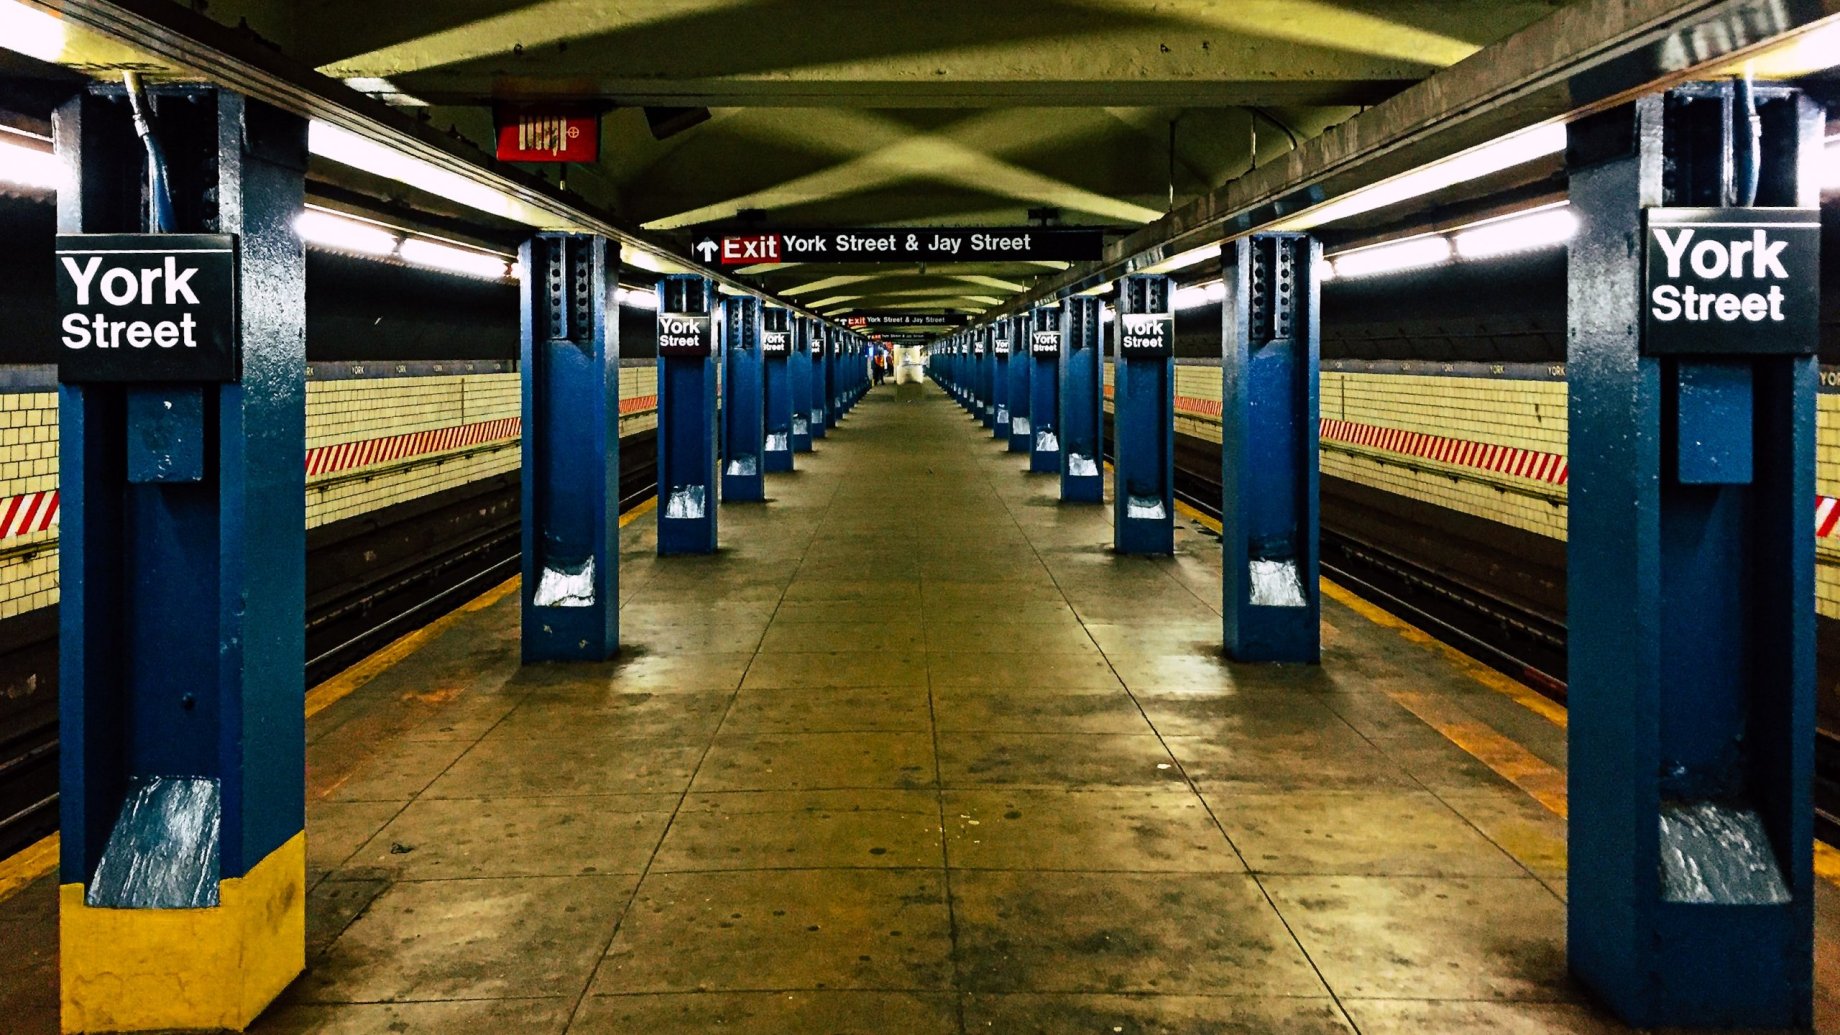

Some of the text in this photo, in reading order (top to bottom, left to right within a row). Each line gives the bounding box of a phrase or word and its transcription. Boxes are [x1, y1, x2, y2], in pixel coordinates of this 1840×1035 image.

[724, 234, 1031, 258] Exit York Street & Jay Street
[1652, 229, 1790, 279] York
[60, 256, 200, 306] York
[1651, 284, 1786, 322] Street
[659, 318, 701, 334] York
[848, 317, 866, 325] Exit
[1122, 318, 1164, 335] York
[61, 312, 198, 349] Street
[660, 335, 700, 347] Street
[995, 340, 1009, 348] Yor
[1033, 332, 1058, 344] York
[1123, 336, 1163, 348] Street
[351, 365, 365, 375] YORK
[1547, 366, 1566, 376] YORK
